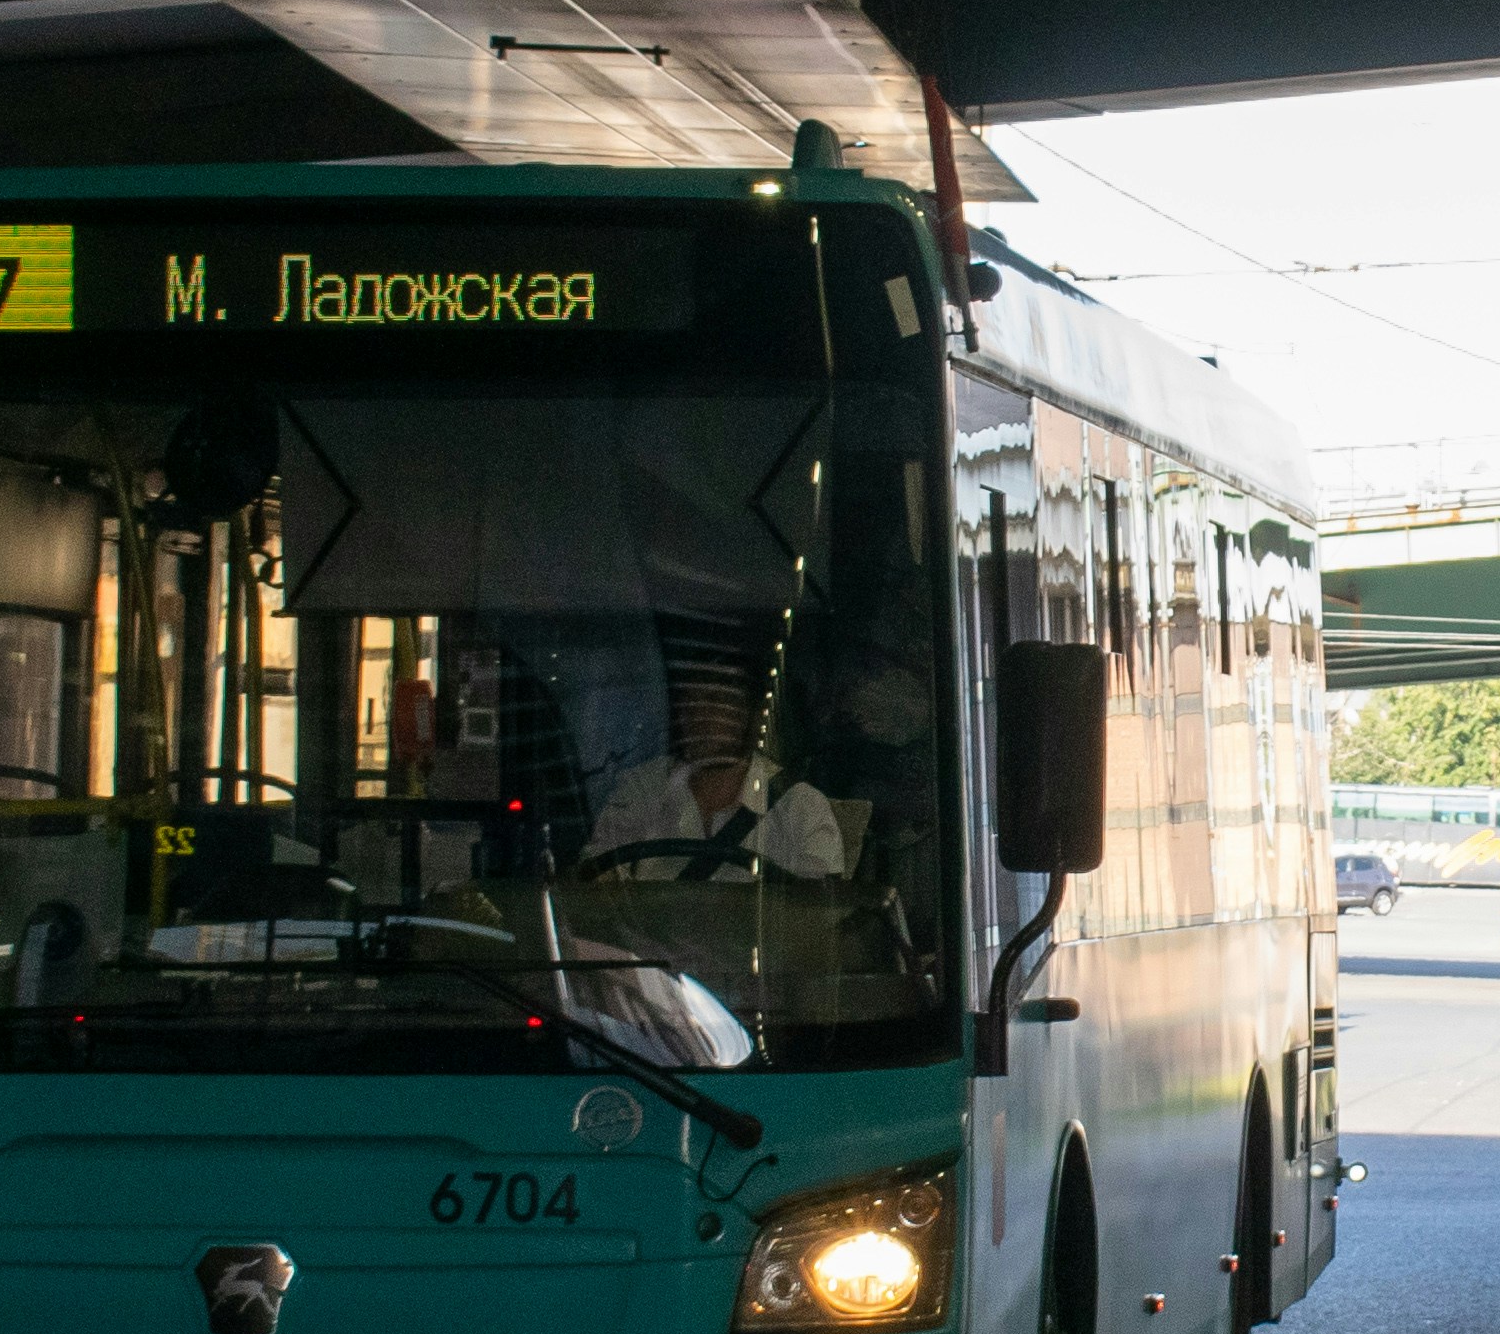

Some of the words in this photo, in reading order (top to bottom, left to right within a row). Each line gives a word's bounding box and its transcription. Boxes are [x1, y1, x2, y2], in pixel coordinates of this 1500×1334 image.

[166, 255, 228, 323] М.
[274, 254, 597, 325] Ладожская
[430, 1172, 580, 1224] 6704
